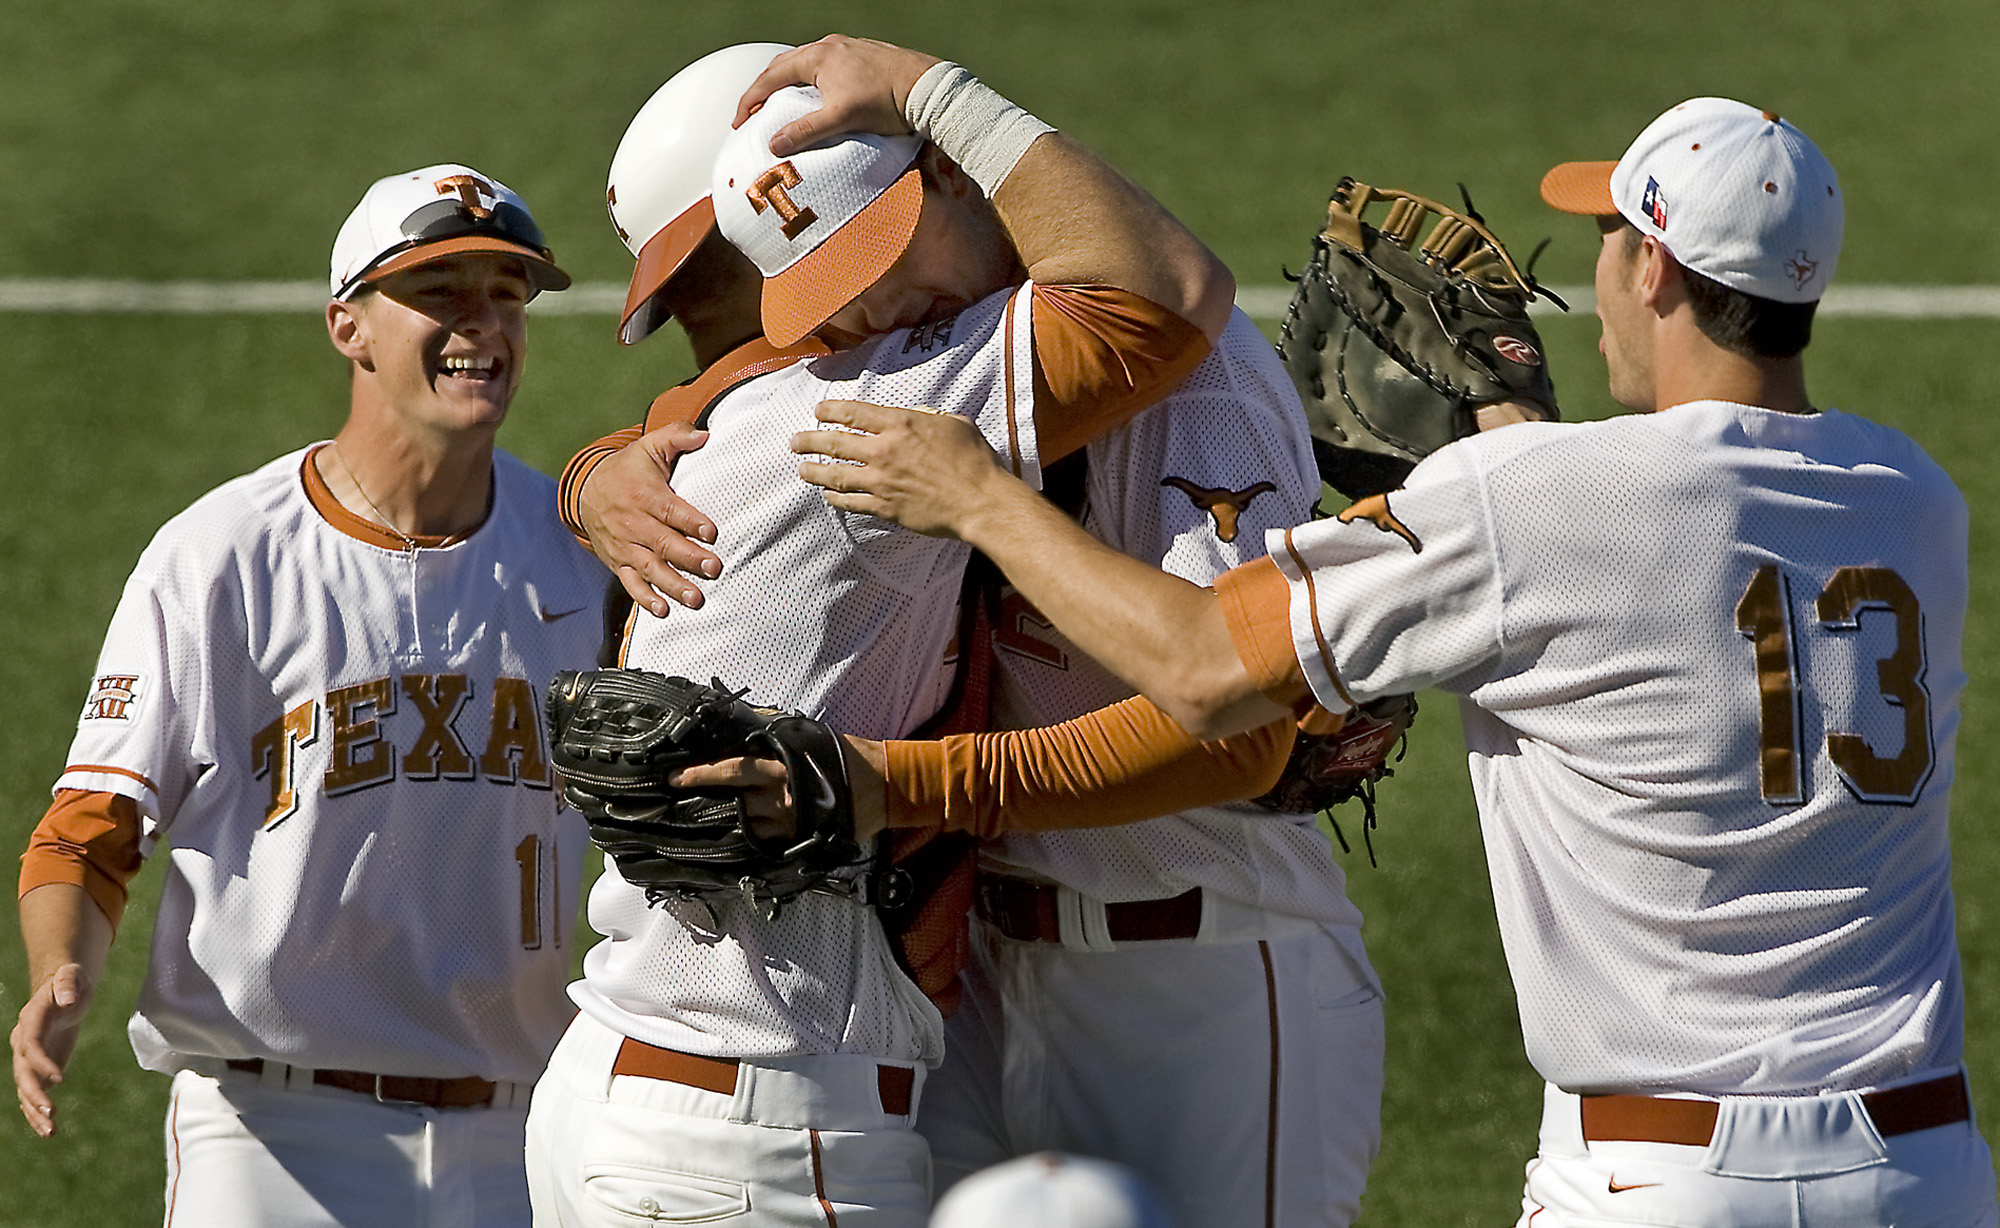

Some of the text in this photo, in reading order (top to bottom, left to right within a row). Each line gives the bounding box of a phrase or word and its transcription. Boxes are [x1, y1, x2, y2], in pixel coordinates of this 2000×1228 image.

[434, 174, 496, 221] T
[746, 160, 819, 242] T
[1734, 562, 1936, 808] 13
[251, 673, 566, 832] TEXA
